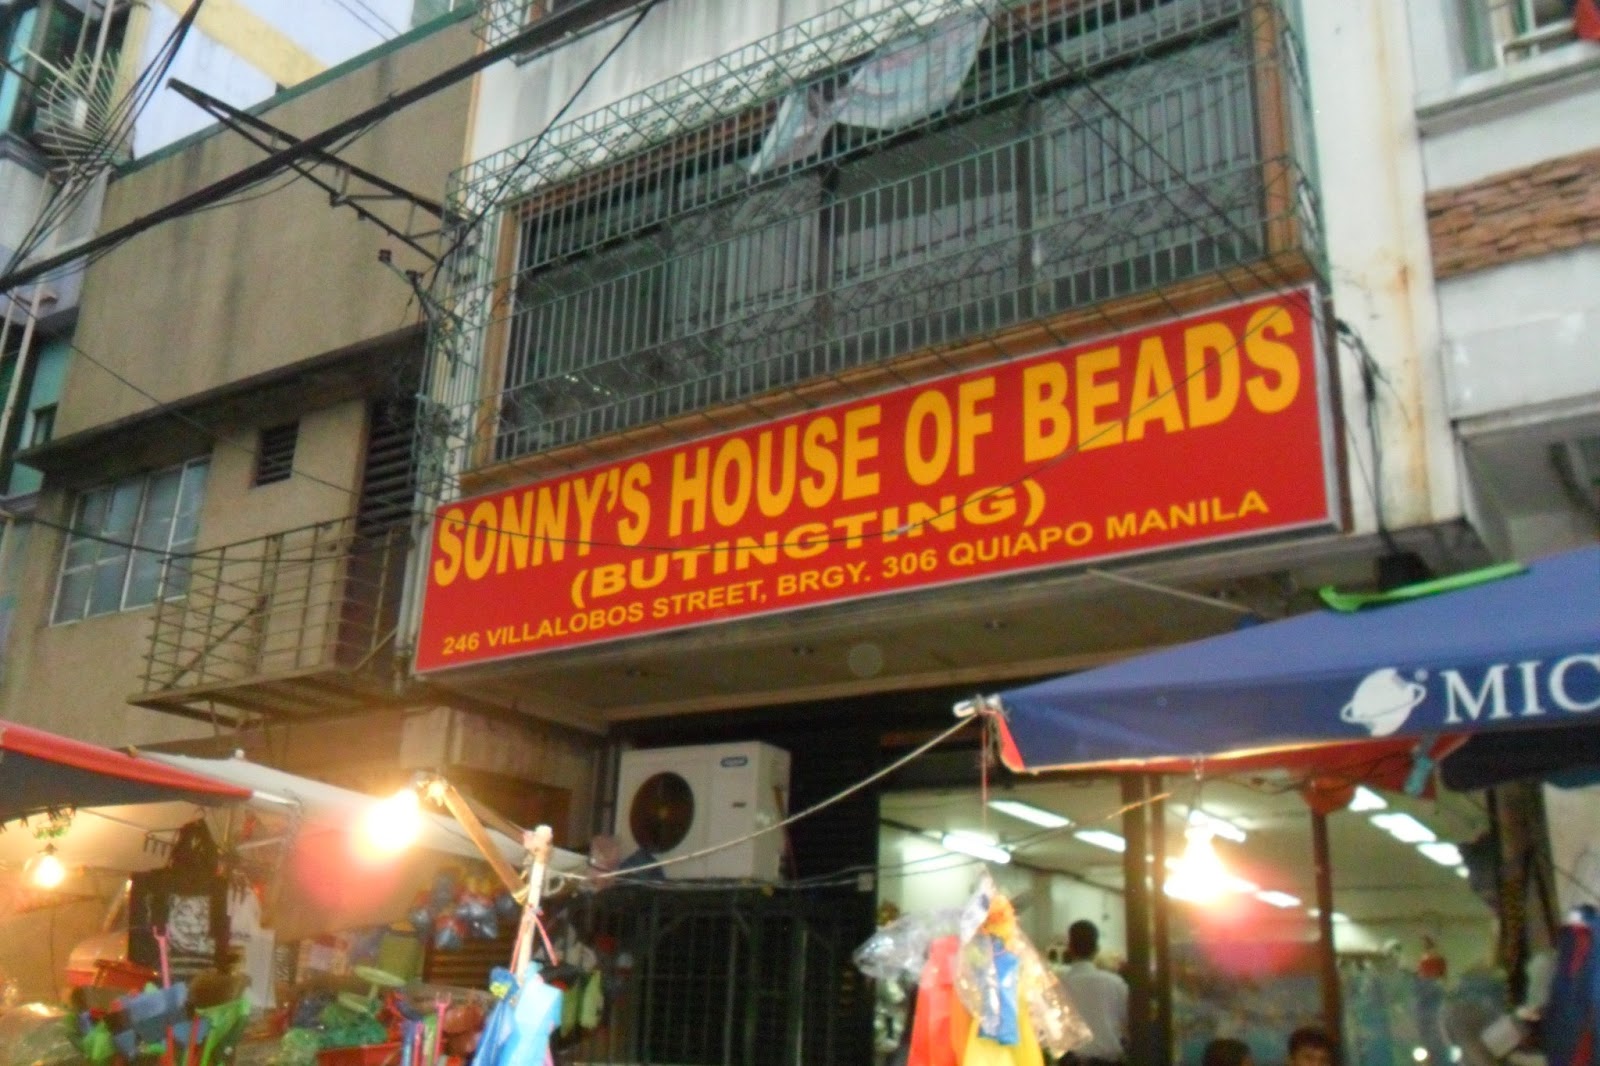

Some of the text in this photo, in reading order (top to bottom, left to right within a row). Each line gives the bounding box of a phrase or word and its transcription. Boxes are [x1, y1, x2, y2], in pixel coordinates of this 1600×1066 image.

[433, 305, 1301, 587] SONNY'S HOUSE OF BEADS
[441, 490, 1269, 656] 246 VILLALOBOS STREET, BRGY. 306 QUIAPO MANILA
[570, 479, 1046, 609] (BUTINGTING)
